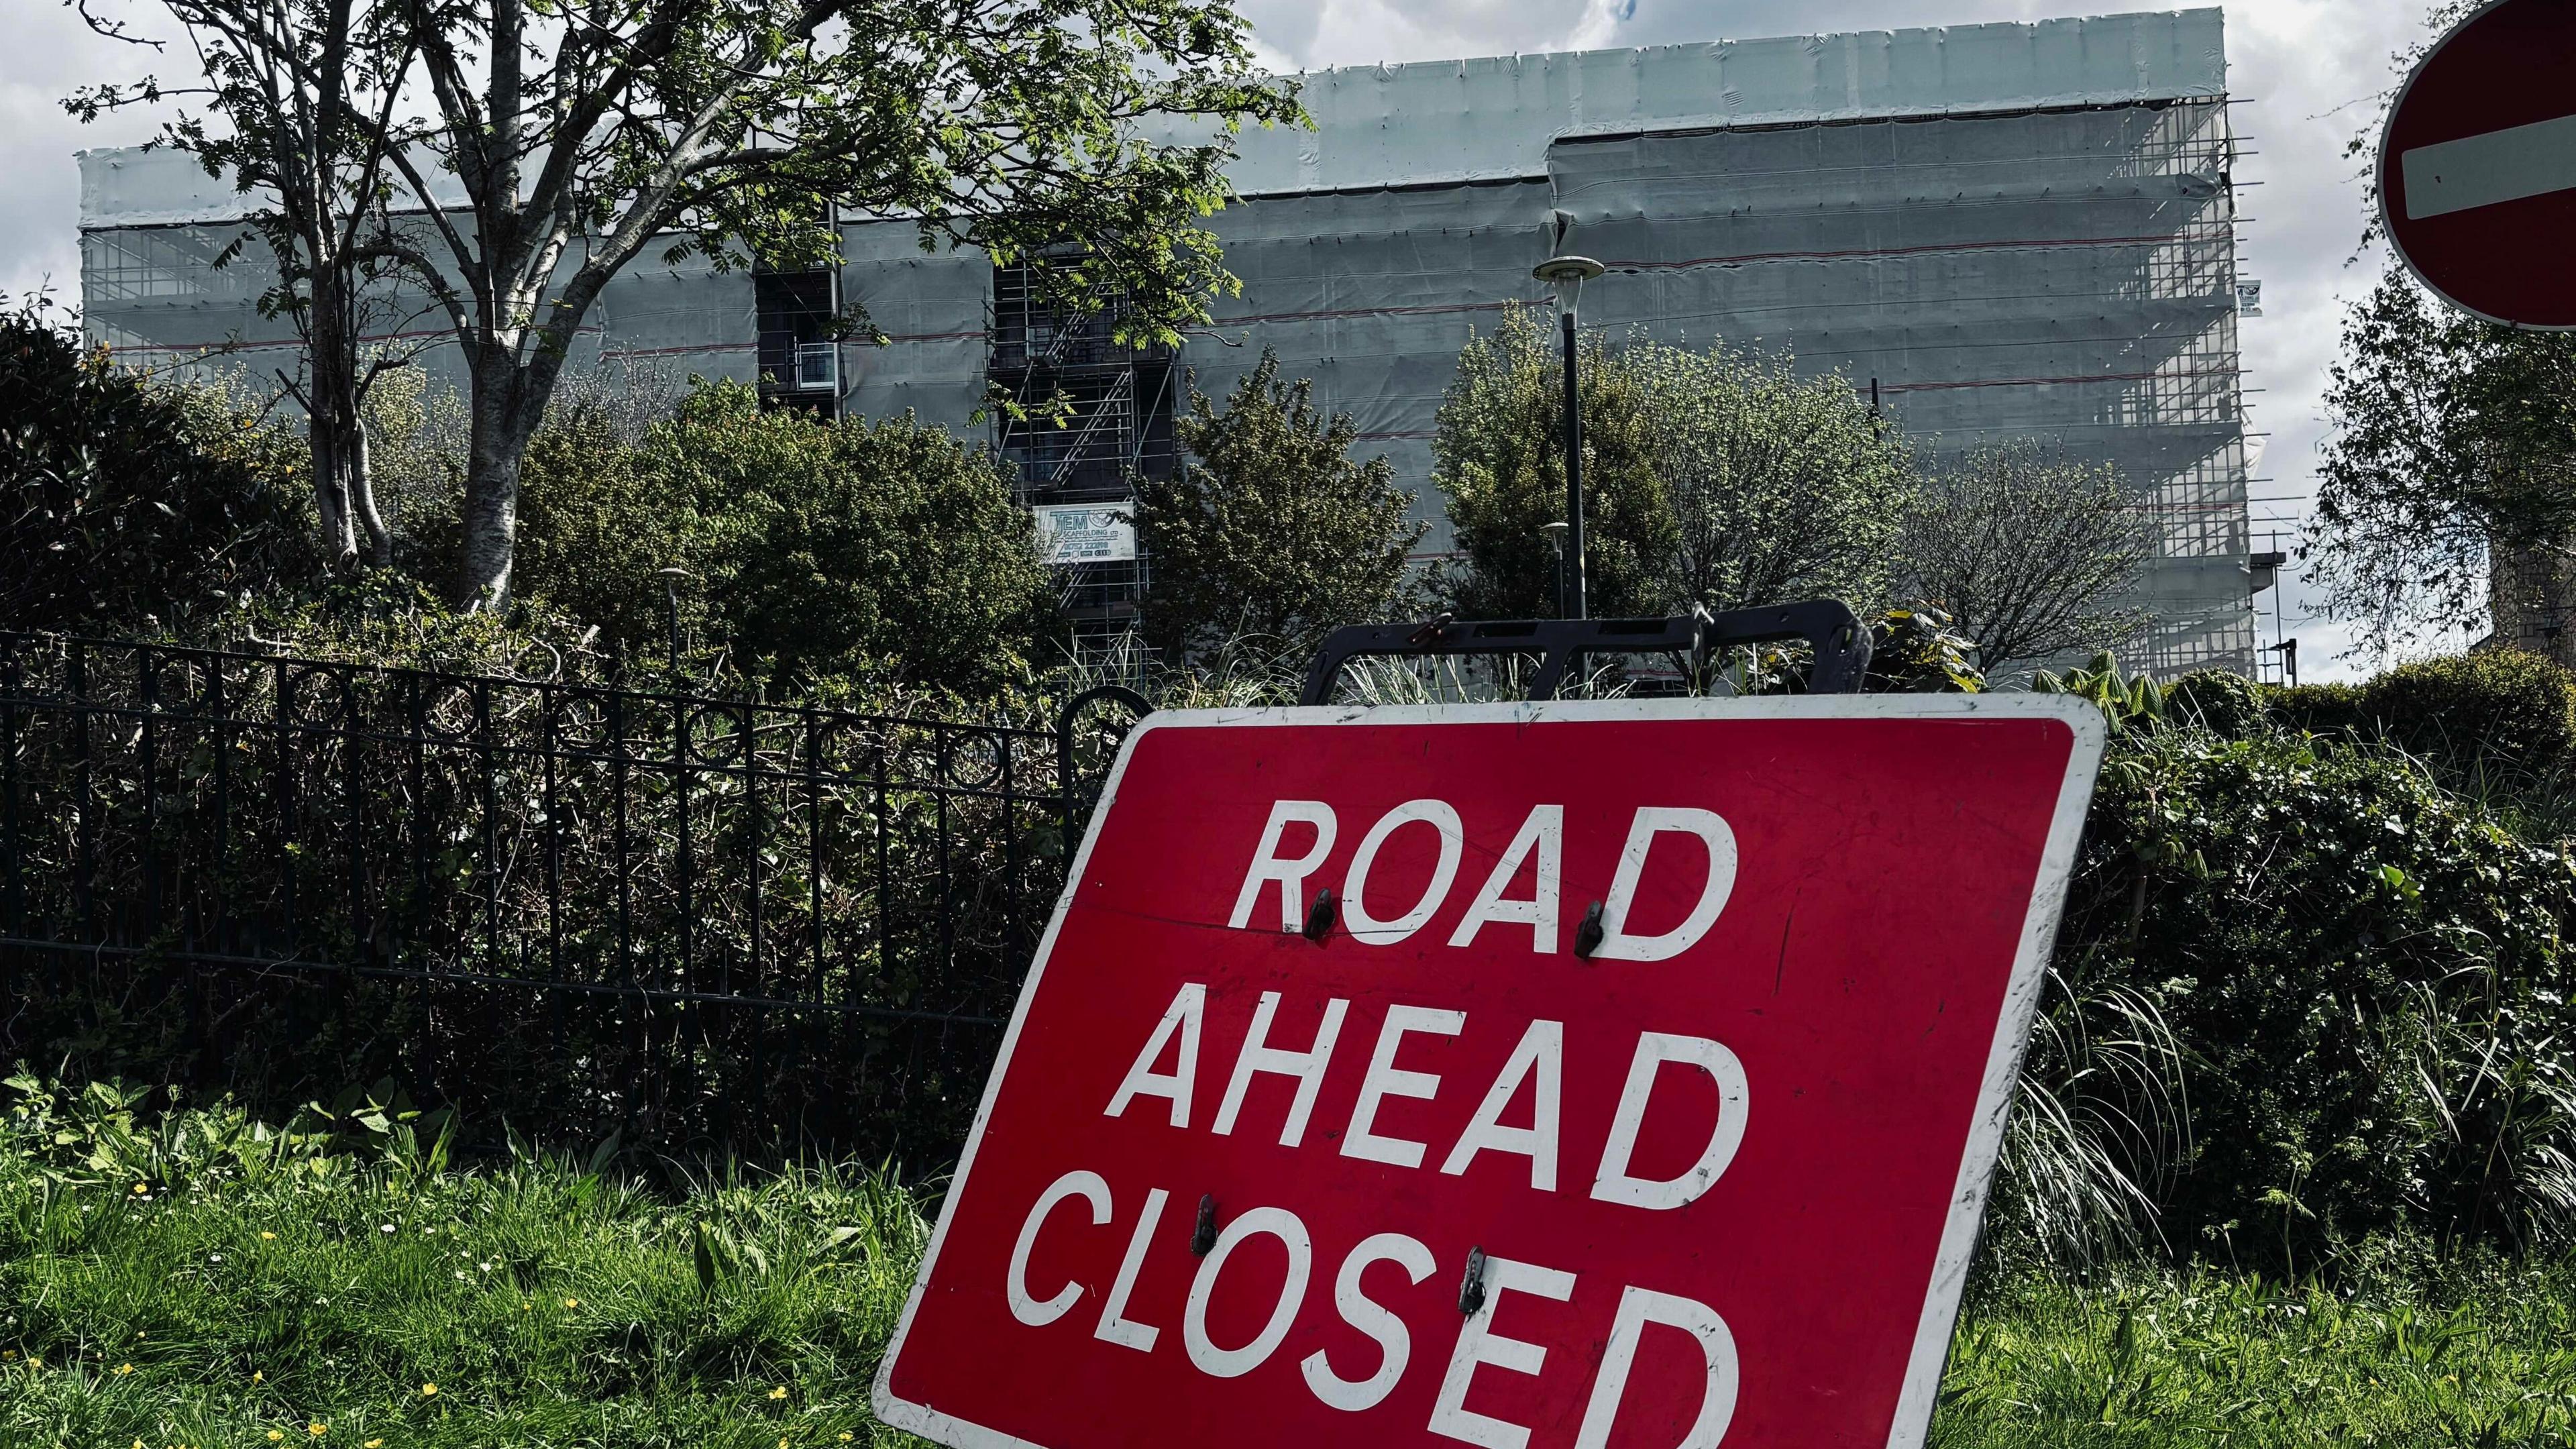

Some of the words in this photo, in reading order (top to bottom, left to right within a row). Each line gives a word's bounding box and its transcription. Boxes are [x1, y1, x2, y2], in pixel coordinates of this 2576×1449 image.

[1228, 799, 1738, 962] ROAD
[1104, 982, 1750, 1210] AHEAD
[1007, 1170, 1739, 1449] CLOSED
